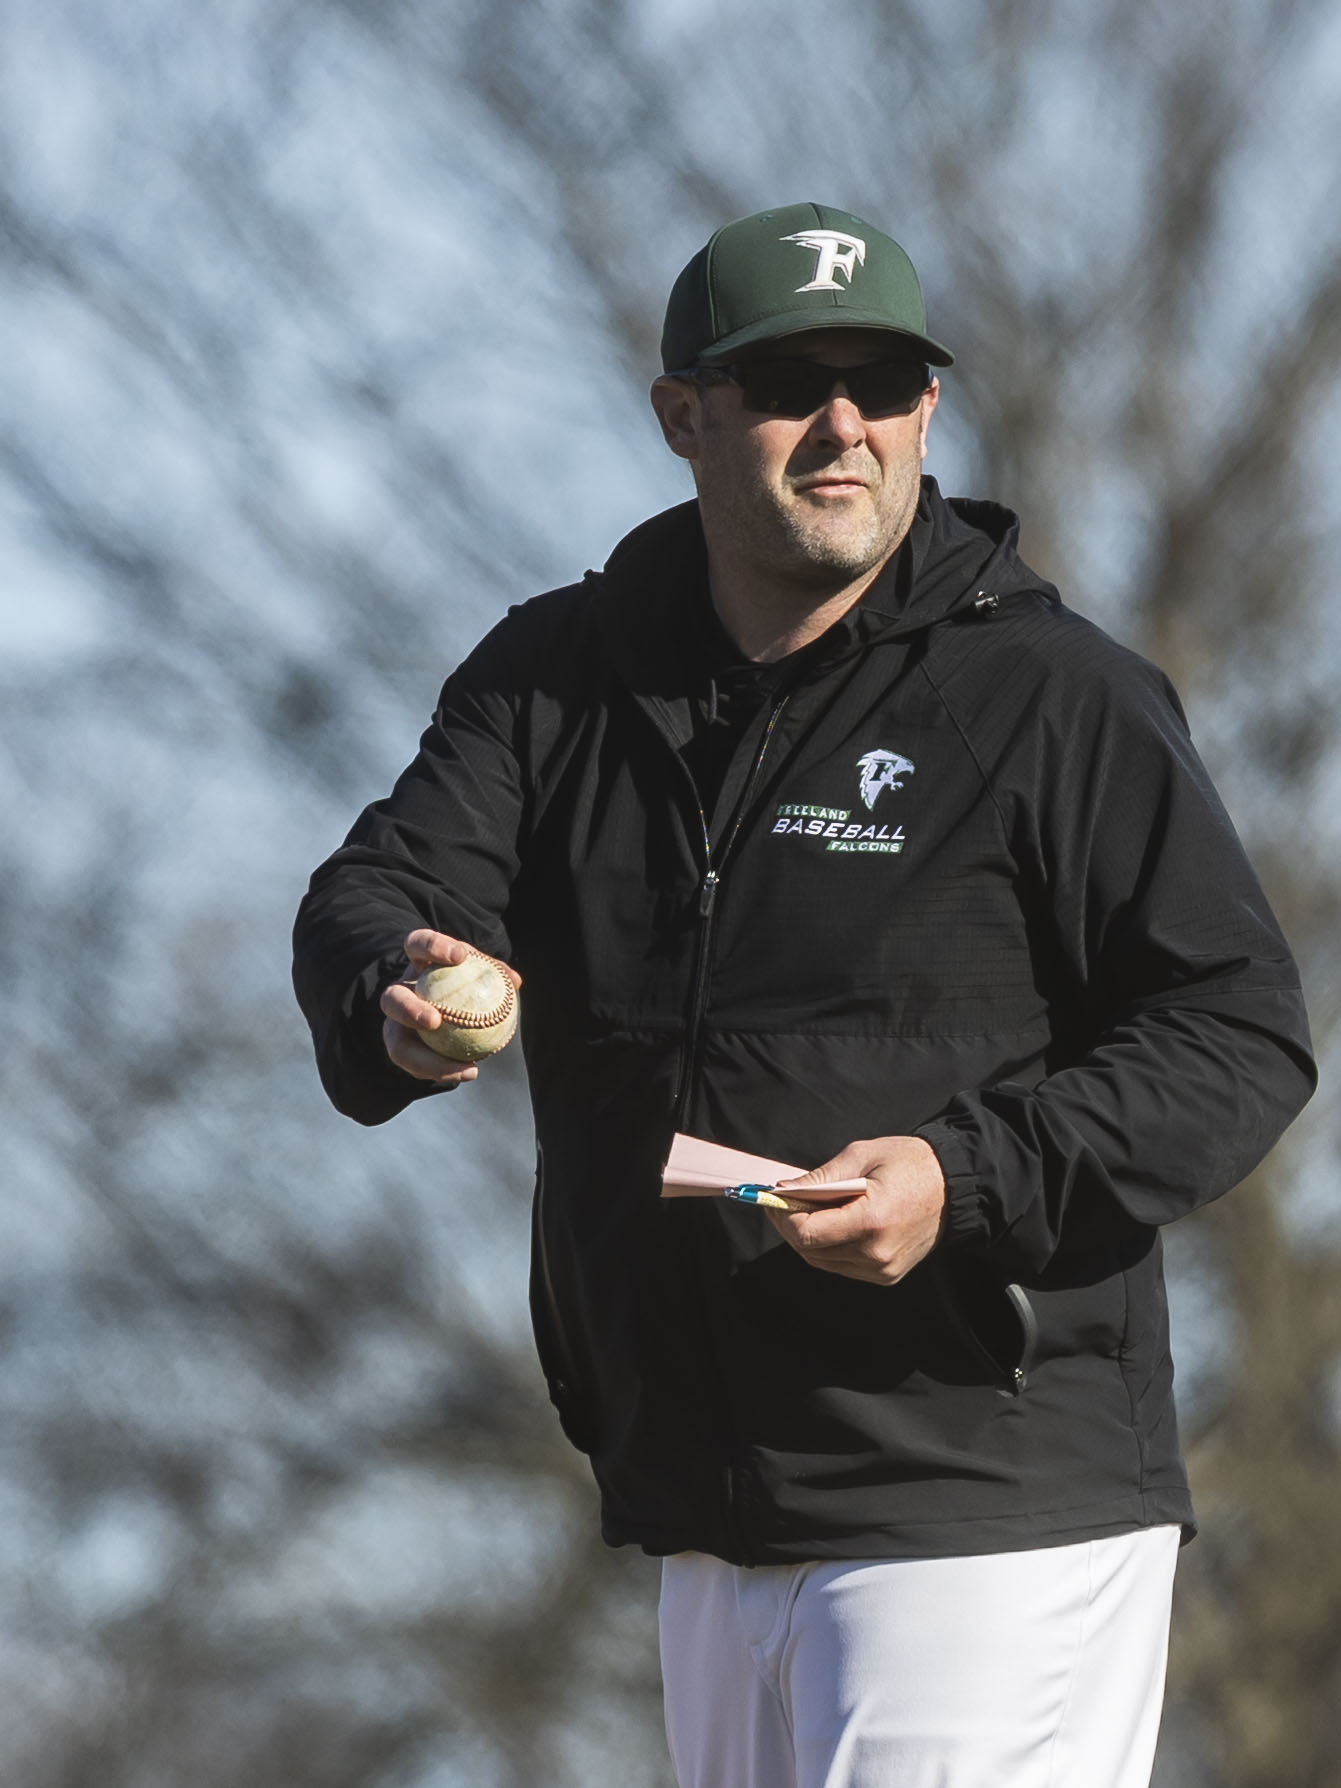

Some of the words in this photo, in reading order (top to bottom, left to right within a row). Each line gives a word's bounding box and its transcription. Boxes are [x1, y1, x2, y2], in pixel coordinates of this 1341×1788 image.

[778, 229, 866, 293] F
[771, 818, 906, 840] BASEBALL
[831, 841, 900, 853] FALCONS
